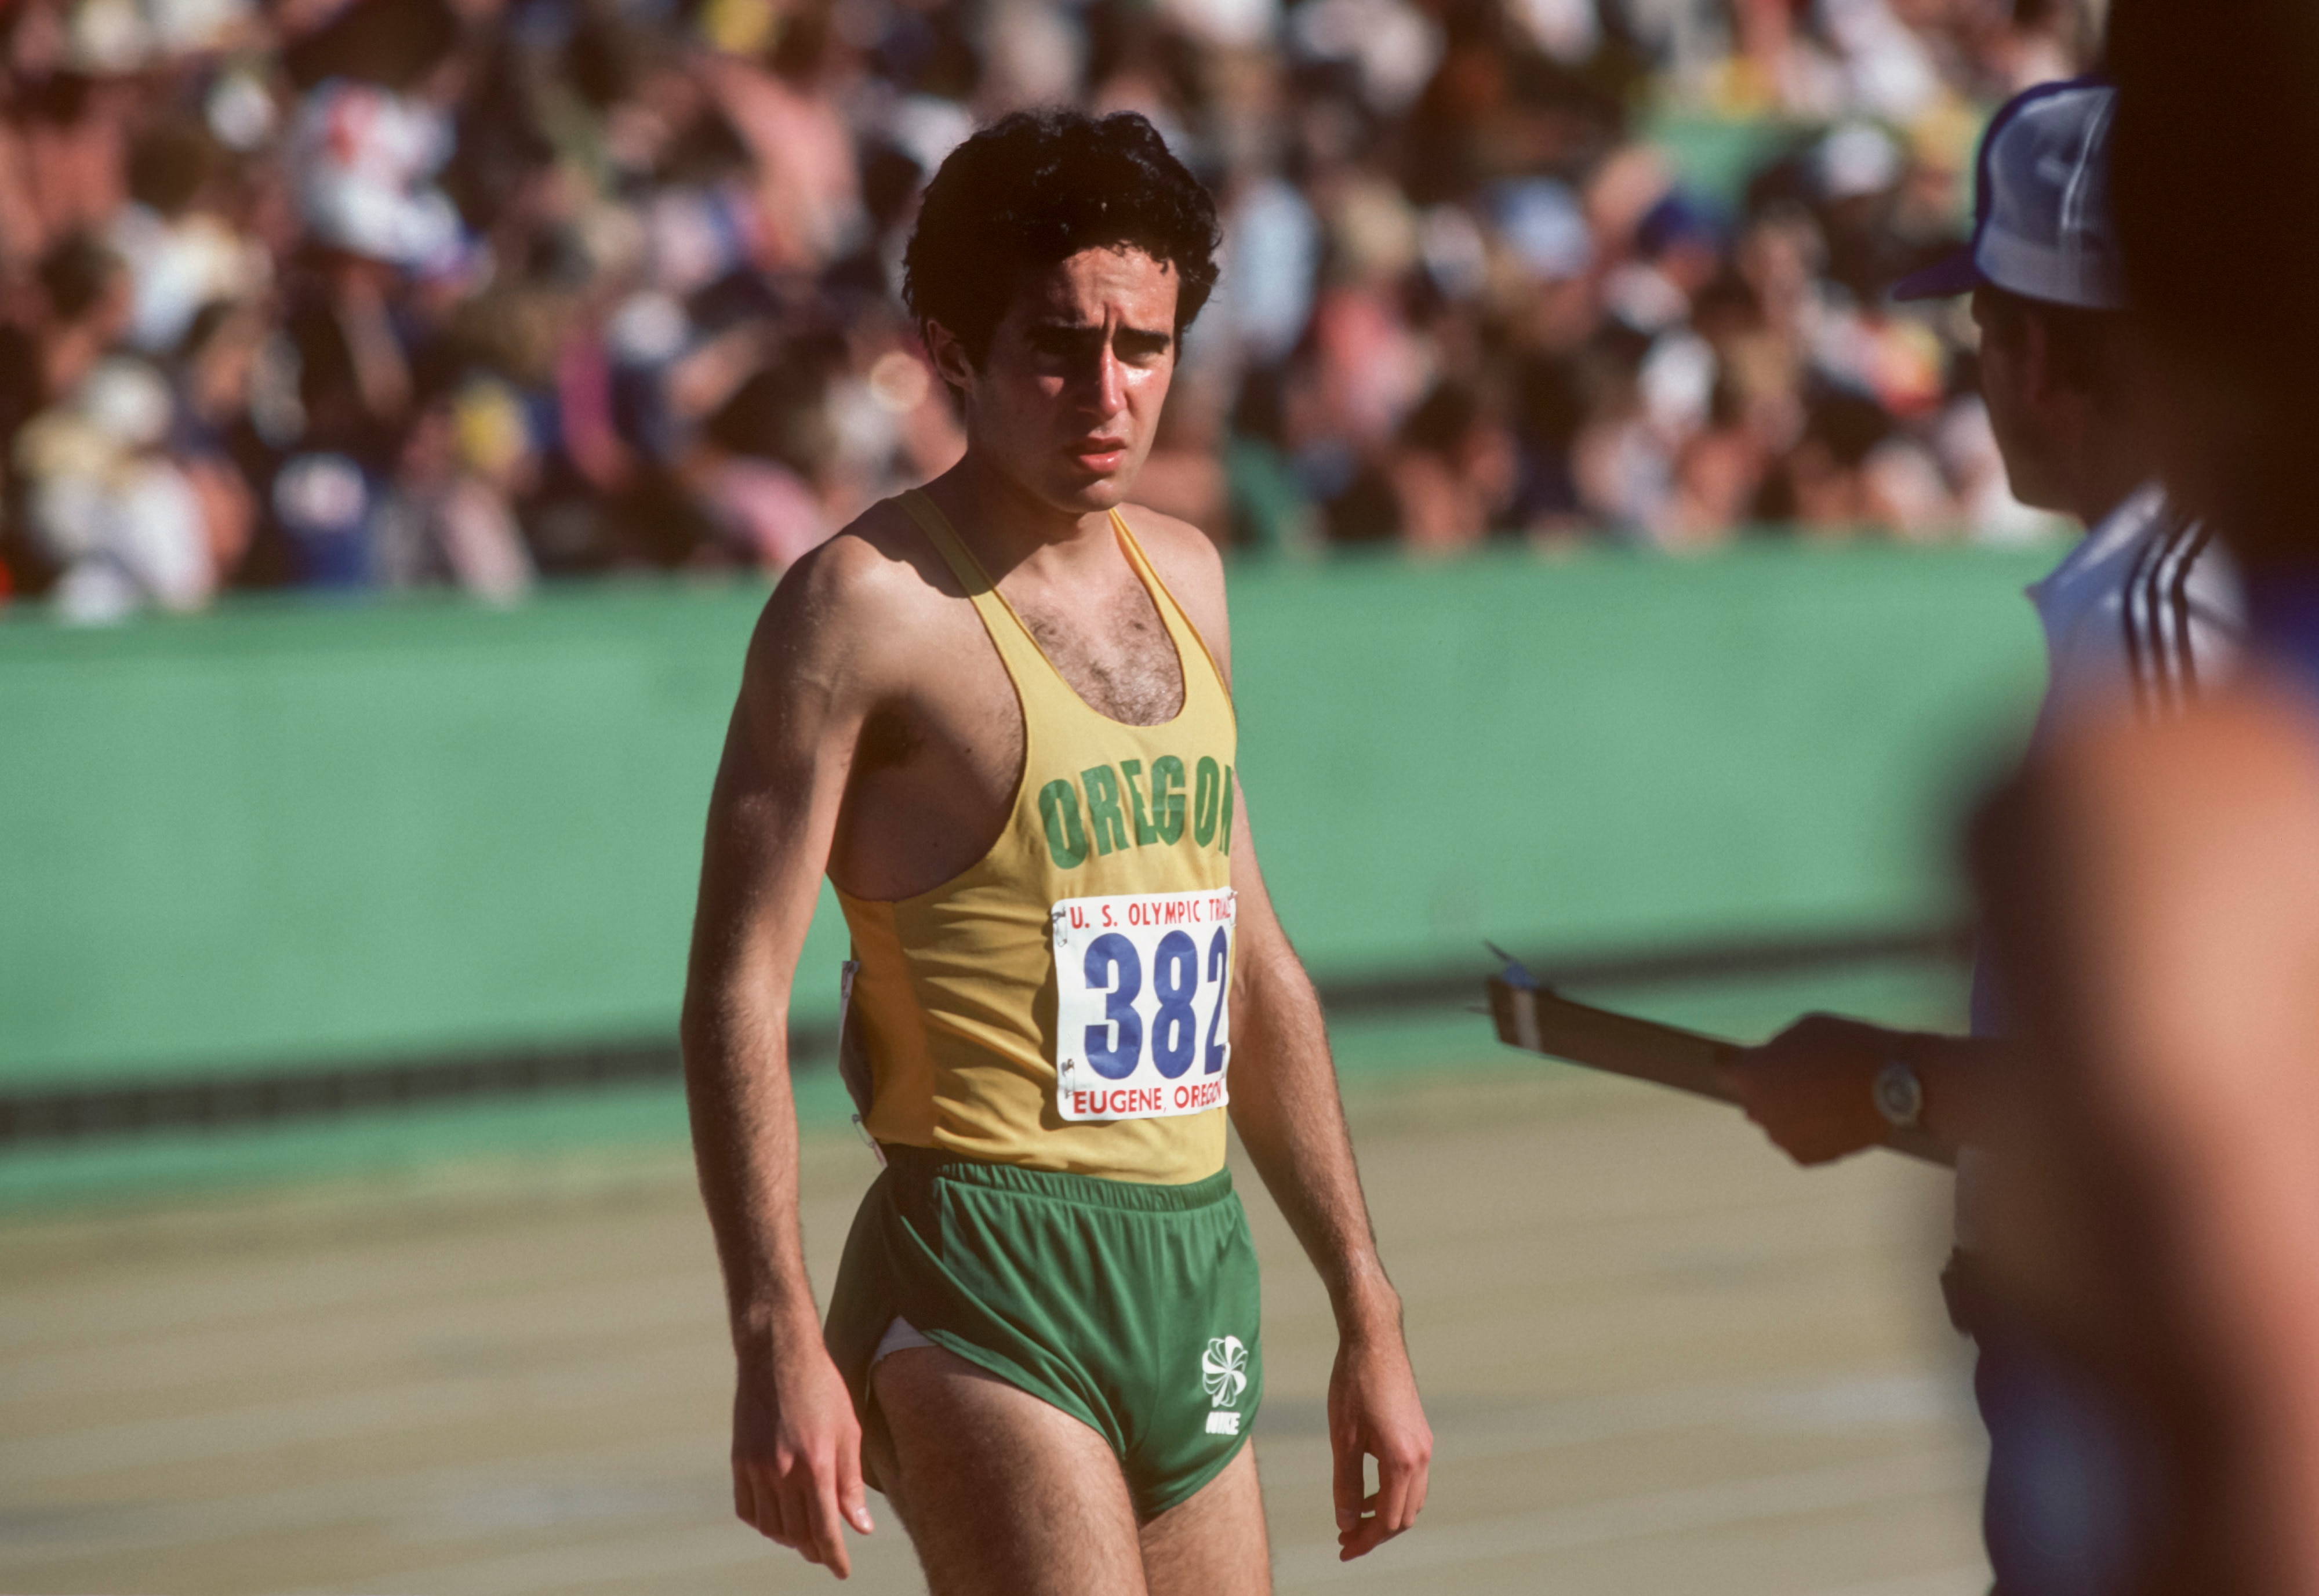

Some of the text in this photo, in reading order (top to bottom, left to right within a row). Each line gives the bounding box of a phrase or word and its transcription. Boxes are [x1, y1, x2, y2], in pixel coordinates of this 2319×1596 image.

[1069, 906, 1090, 929] U.
[1102, 904, 1118, 927] S.
[1128, 900, 1201, 926] OLYMPIC
[1084, 925, 1227, 1079] 382
[1074, 1088, 1166, 1114] EUGENE,
[1206, 1411, 1241, 1435] NIKE
